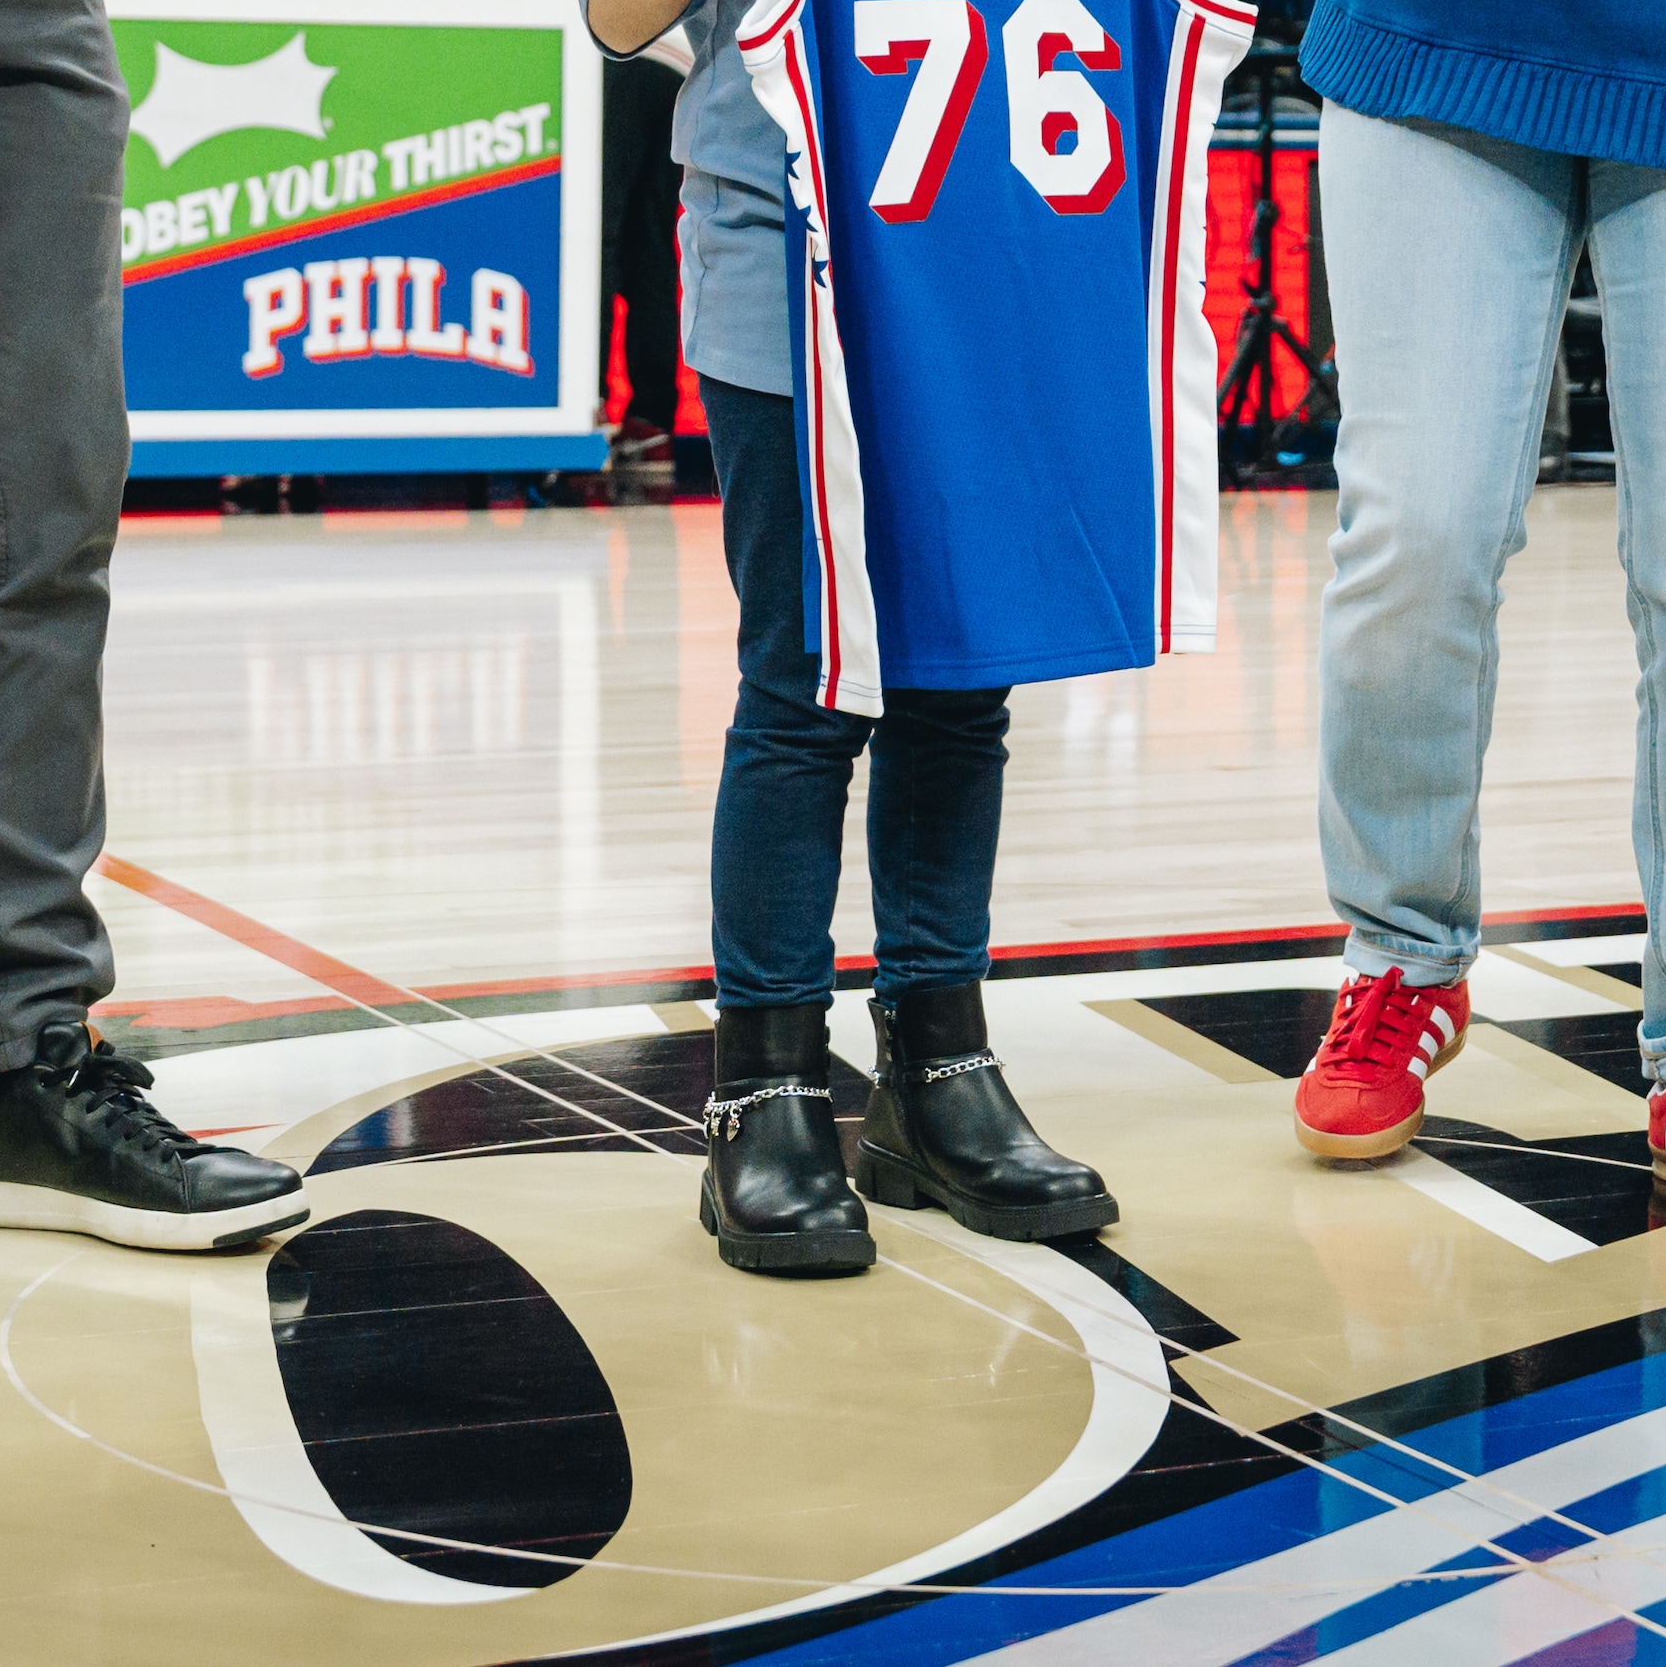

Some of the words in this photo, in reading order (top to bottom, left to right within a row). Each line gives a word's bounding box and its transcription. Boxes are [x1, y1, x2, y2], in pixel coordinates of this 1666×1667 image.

[120, 182, 239, 262] OBEY
[245, 149, 378, 228] YOUR
[383, 102, 551, 191] THIRST
[241, 255, 535, 380] PHILA
